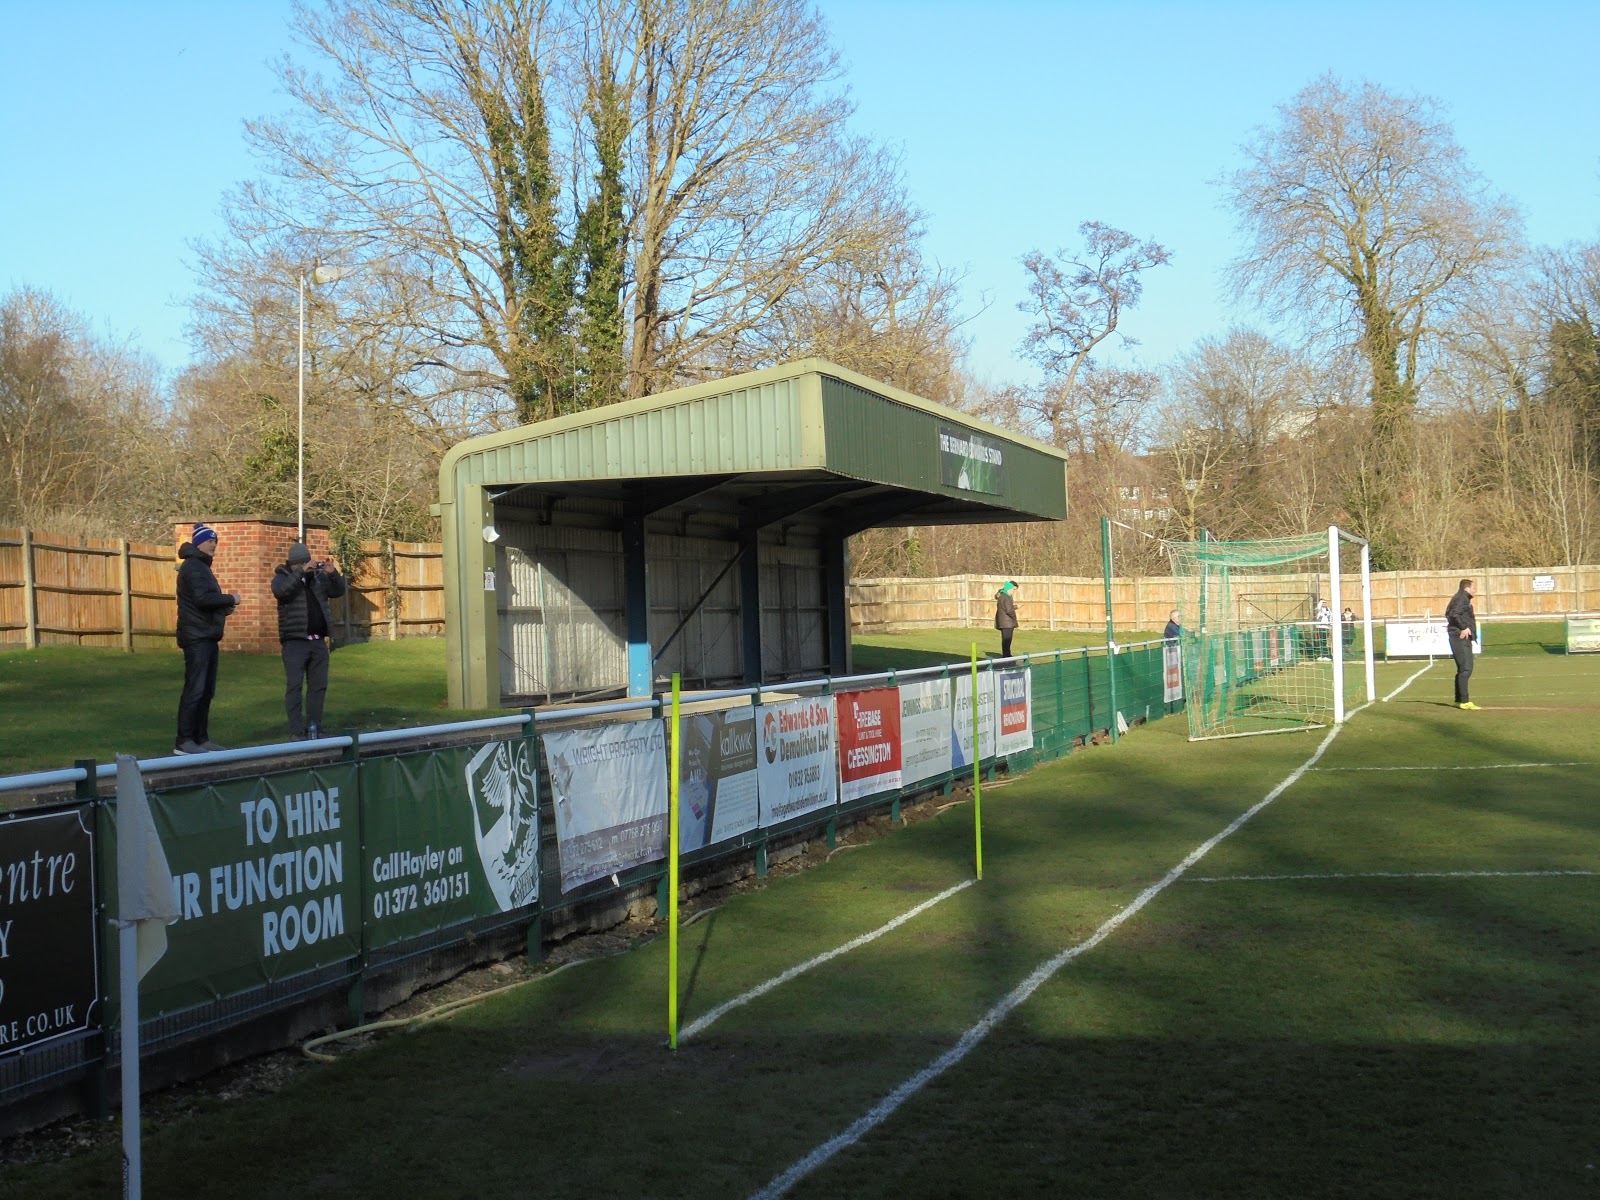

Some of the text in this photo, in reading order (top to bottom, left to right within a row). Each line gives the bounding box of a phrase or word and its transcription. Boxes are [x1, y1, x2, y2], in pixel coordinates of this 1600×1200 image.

[989, 447, 1002, 466] STAND
[778, 704, 809, 733] Edwards
[810, 703, 815, 727] &
[815, 703, 829, 725] Son
[572, 734, 663, 765] WRIGHT PROPERTY LTD
[779, 727, 829, 762] Demolition Ltd
[848, 742, 891, 769] CHESSINGTON
[240, 786, 341, 846] TO HIRE
[210, 842, 342, 914] FUNCTION
[373, 844, 463, 883] Call Hayley on
[373, 872, 470, 919] 01372 360151
[263, 894, 344, 957] ROOM
